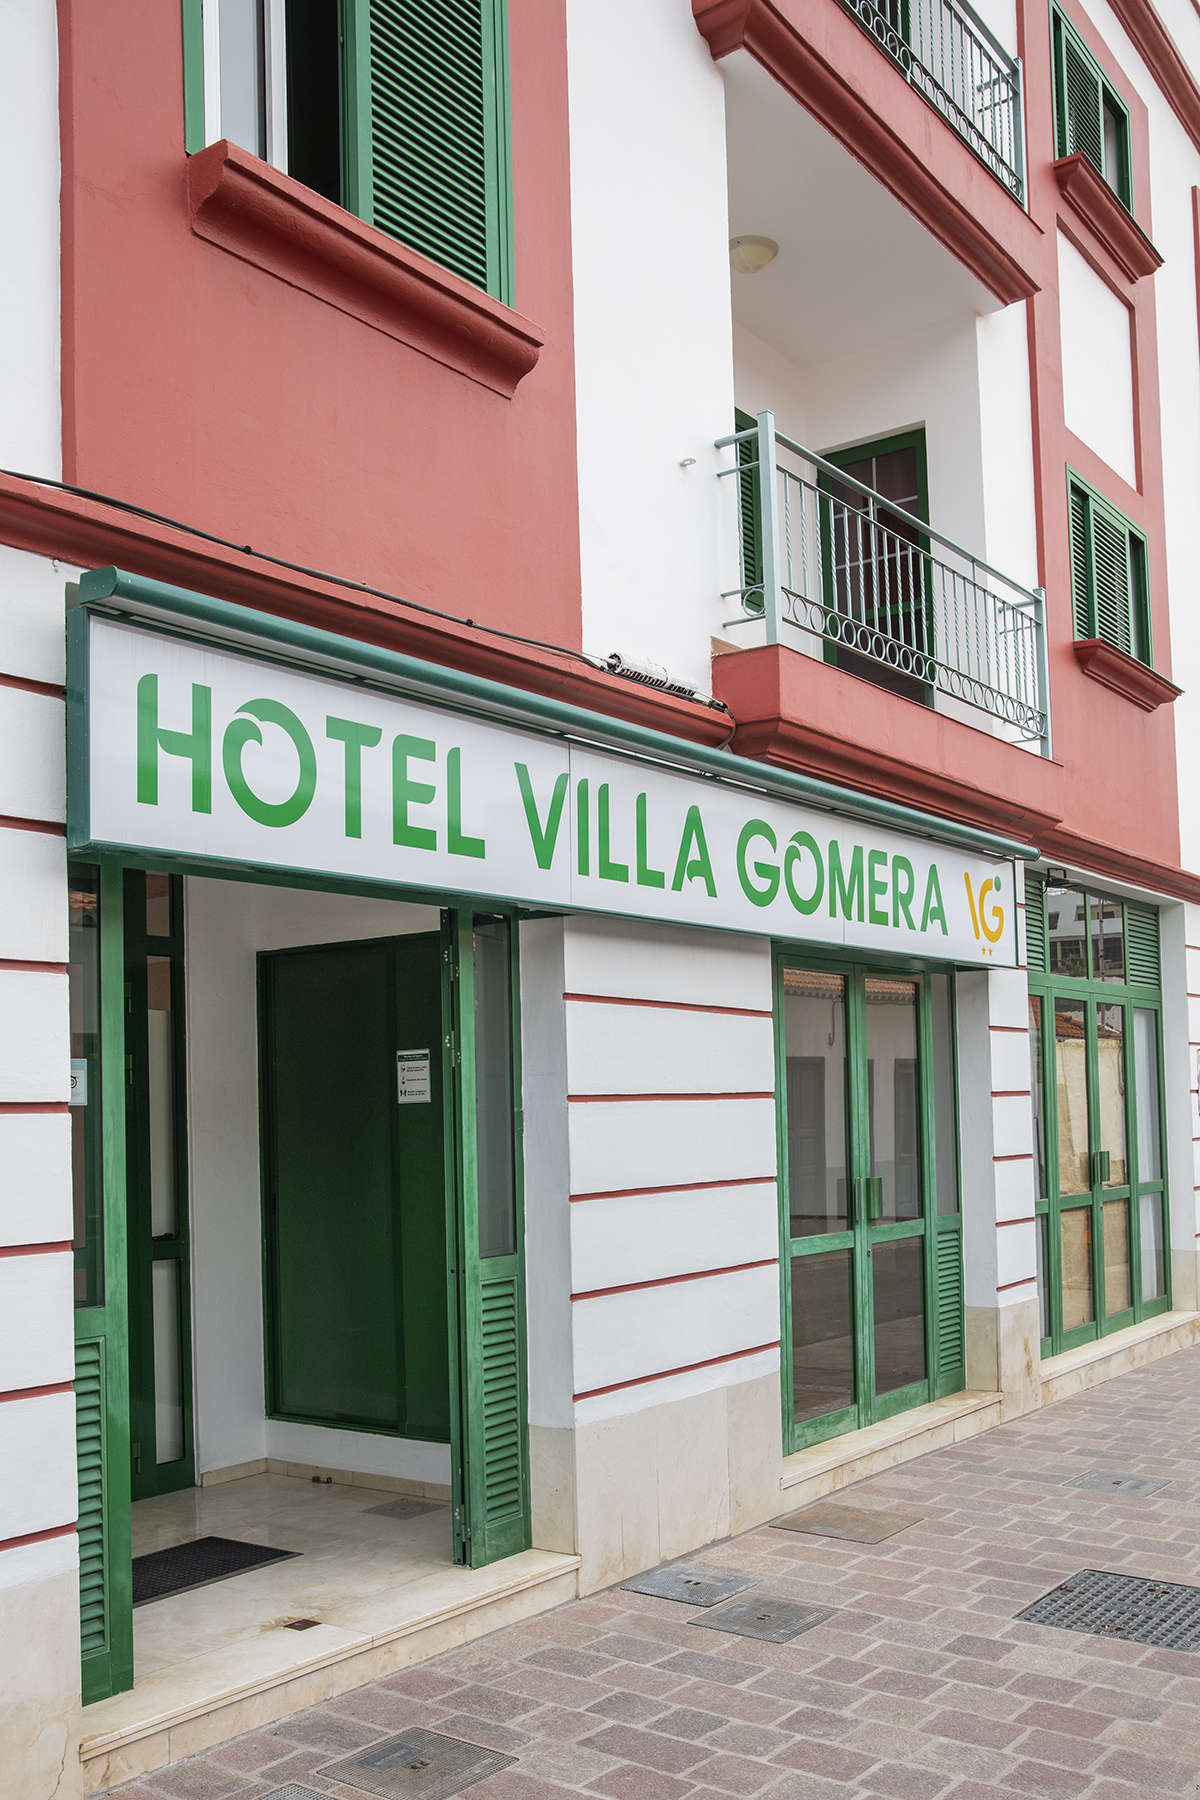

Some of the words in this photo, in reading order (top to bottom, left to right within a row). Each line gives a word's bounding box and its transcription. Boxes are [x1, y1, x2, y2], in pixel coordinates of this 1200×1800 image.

[137, 674, 485, 858] HOTEL
[515, 763, 717, 897] VILLA
[737, 820, 948, 935] GOMERA
